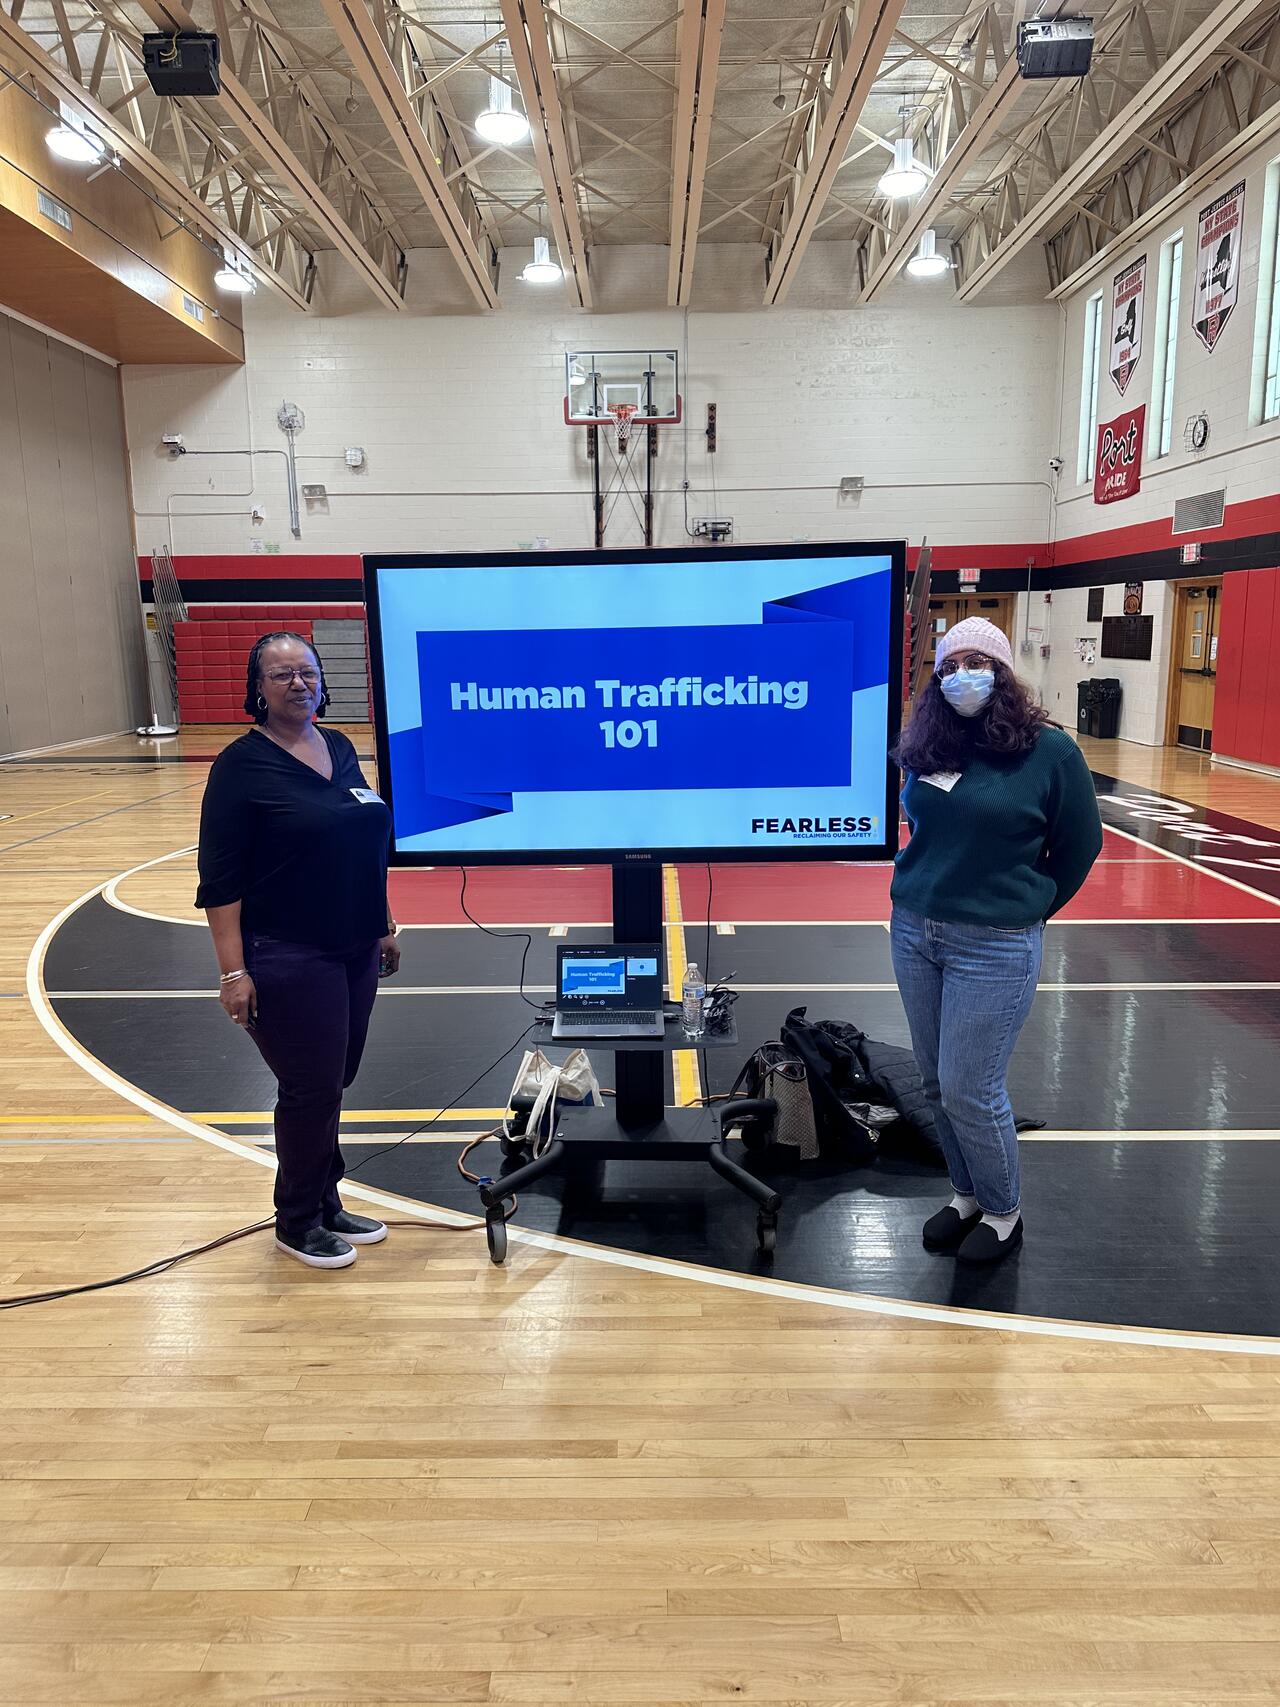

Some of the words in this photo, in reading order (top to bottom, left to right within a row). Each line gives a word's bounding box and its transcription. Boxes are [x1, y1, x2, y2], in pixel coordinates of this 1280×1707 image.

[1201, 213, 1240, 249] CHAMPIONS
[1205, 215, 1214, 233] NY
[1214, 199, 1238, 226] STATE
[1115, 280, 1143, 309] CHAMPIONS
[1100, 419, 1138, 476] Port
[450, 682, 586, 710] Human
[595, 675, 809, 709] Trafficking
[599, 719, 658, 748] 101
